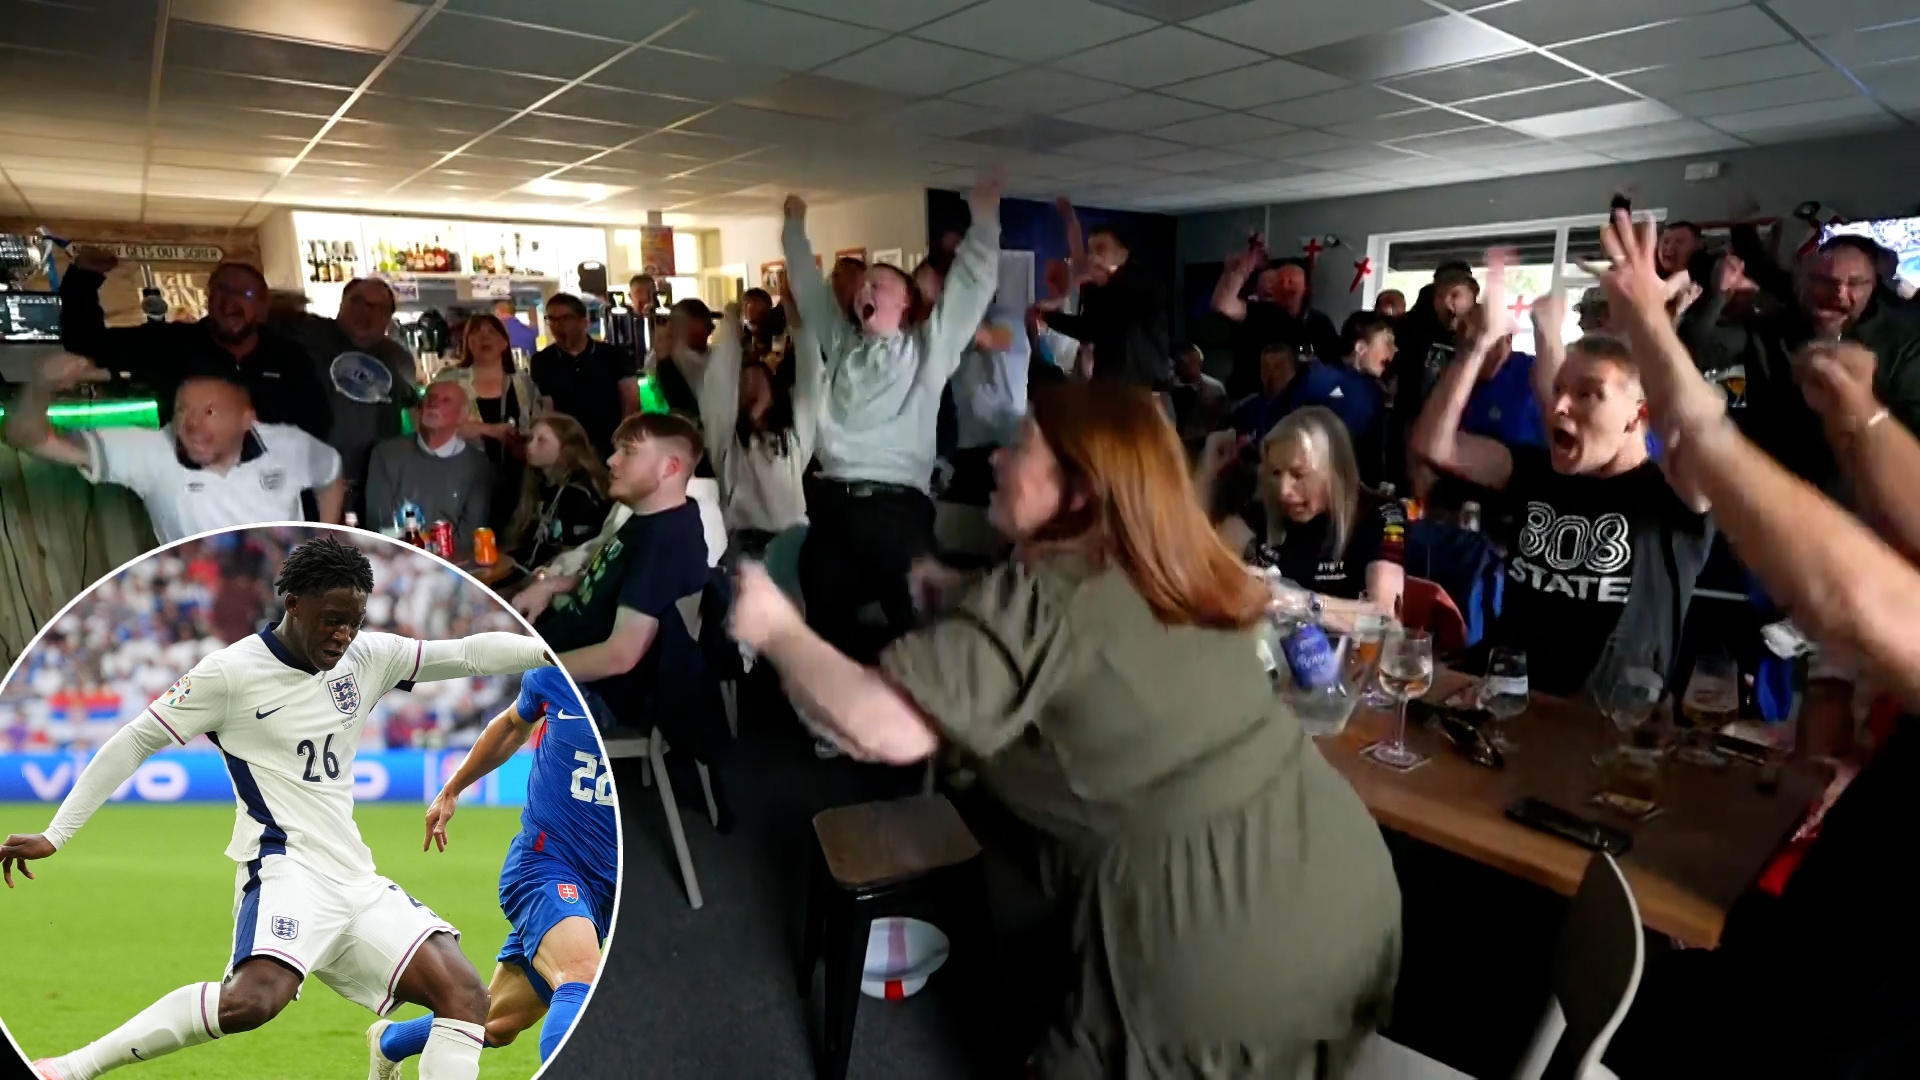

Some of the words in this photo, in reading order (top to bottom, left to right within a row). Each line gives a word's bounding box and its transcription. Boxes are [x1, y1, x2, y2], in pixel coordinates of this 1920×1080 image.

[126, 246, 155, 258] GETS
[157, 246, 180, 258] OUT
[1518, 501, 1631, 574] 808
[1508, 556, 1632, 604] STATE
[297, 733, 341, 783] 26
[570, 750, 614, 806] 22
